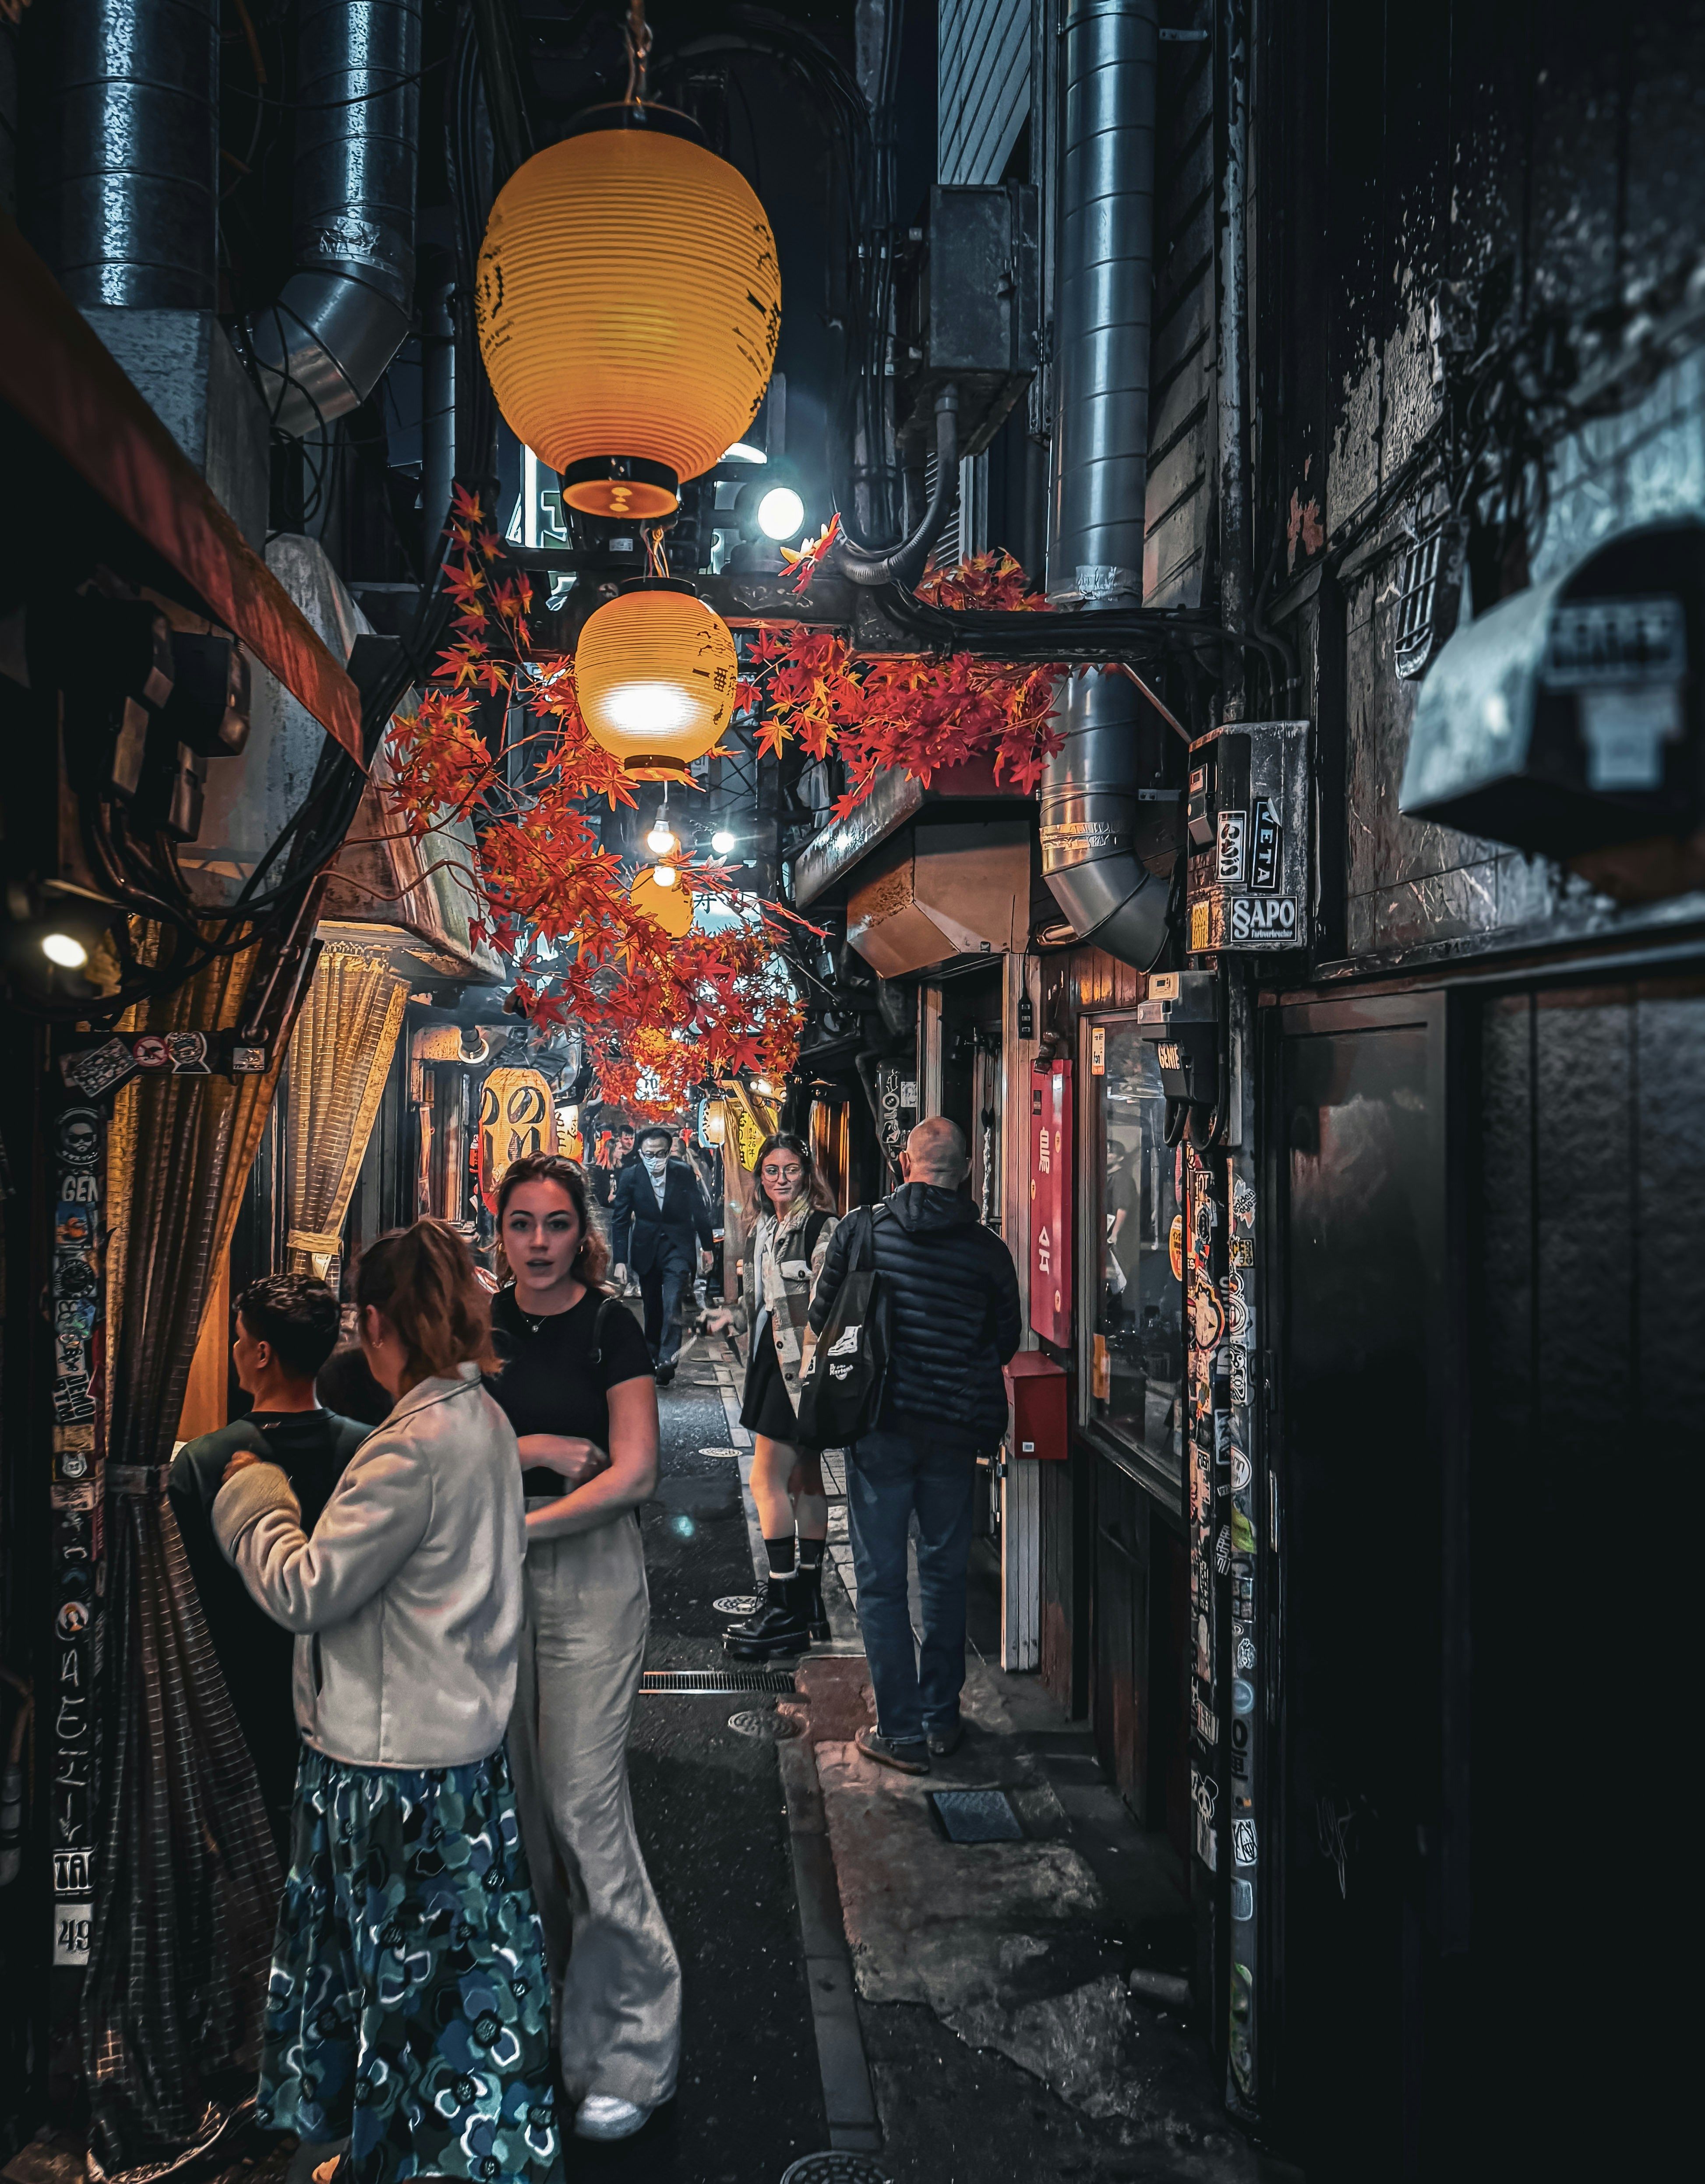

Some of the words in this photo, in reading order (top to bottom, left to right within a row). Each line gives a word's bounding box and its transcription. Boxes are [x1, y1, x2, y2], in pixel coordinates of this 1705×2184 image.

[1158, 1043, 1180, 1070] GENIE
[1233, 1191, 1255, 1213] golden
[1240, 1201, 1253, 1214] eye
